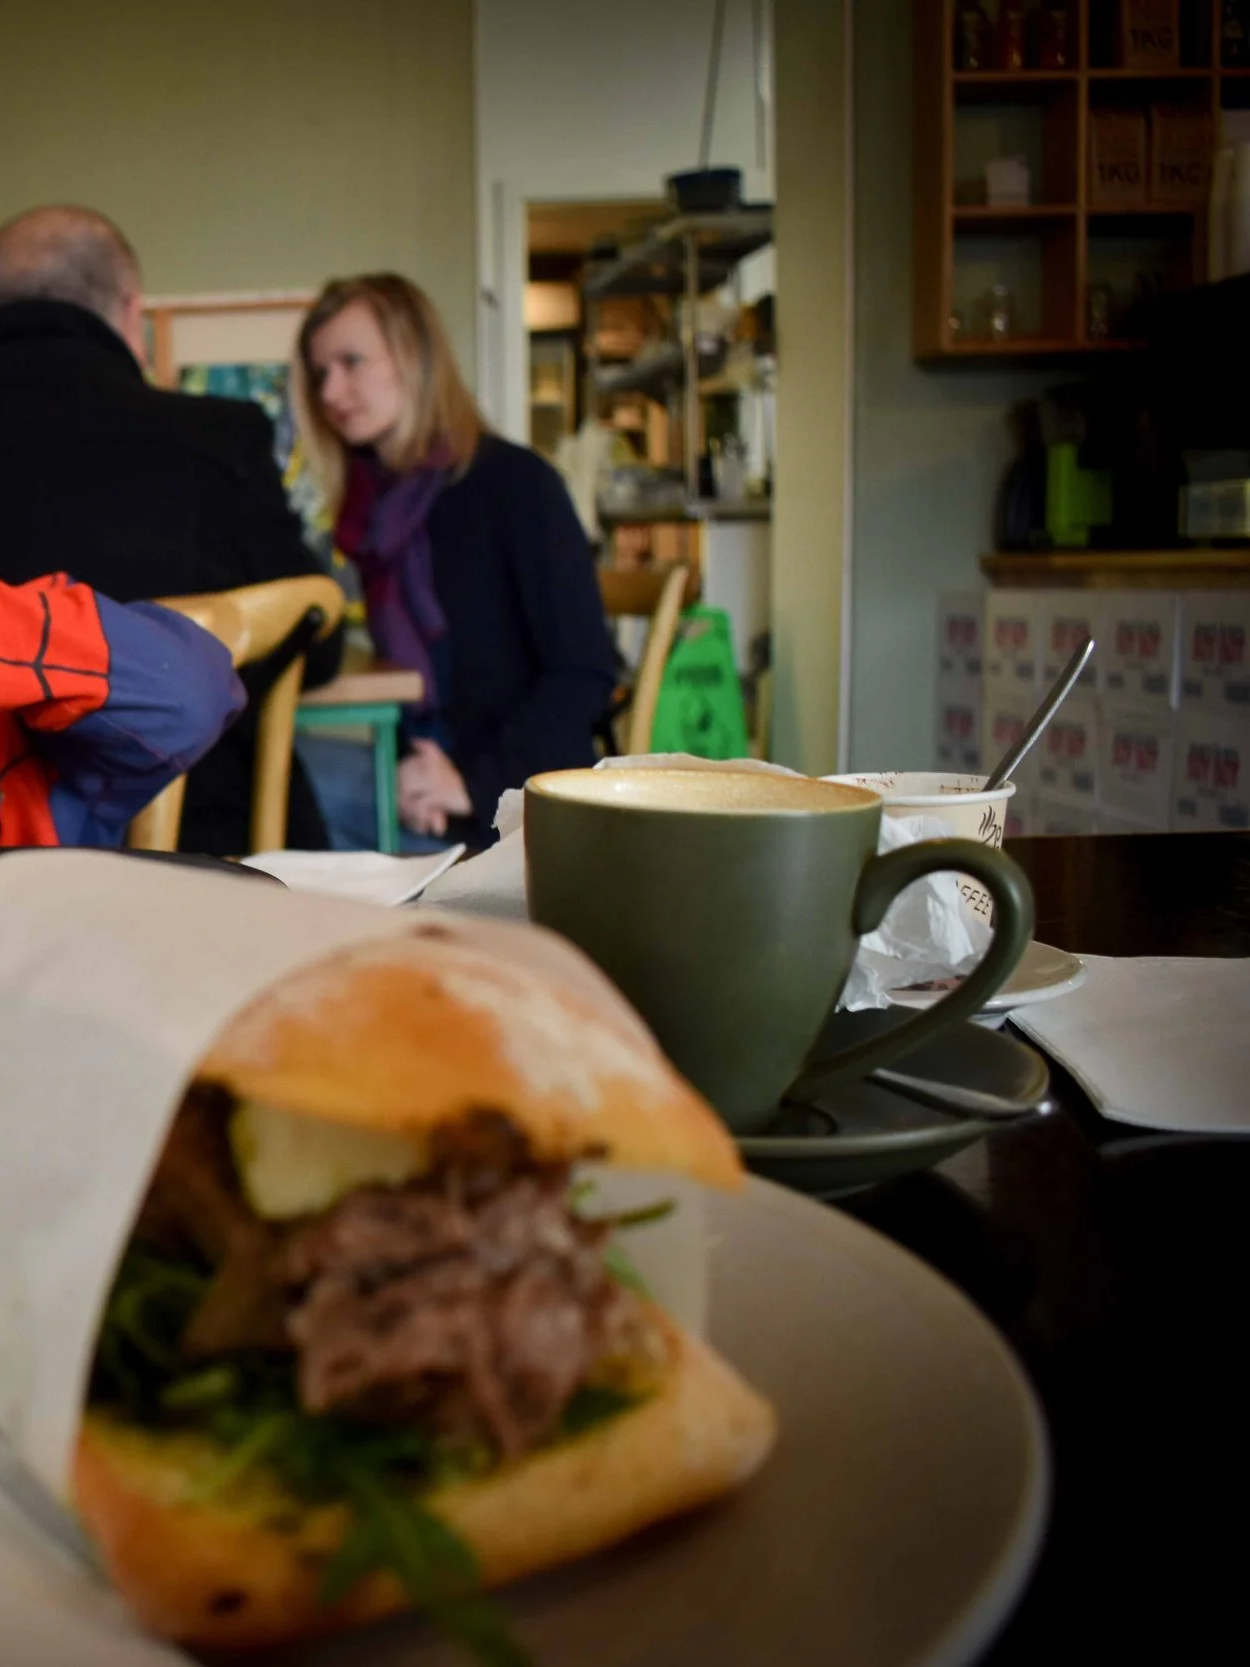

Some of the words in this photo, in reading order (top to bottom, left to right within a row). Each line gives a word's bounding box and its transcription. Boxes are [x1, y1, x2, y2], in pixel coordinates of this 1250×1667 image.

[1131, 26, 1174, 50] 1KG
[1098, 161, 1141, 185] 1KG
[1160, 161, 1202, 185] 1KG
[956, 879, 992, 915] FFEE
